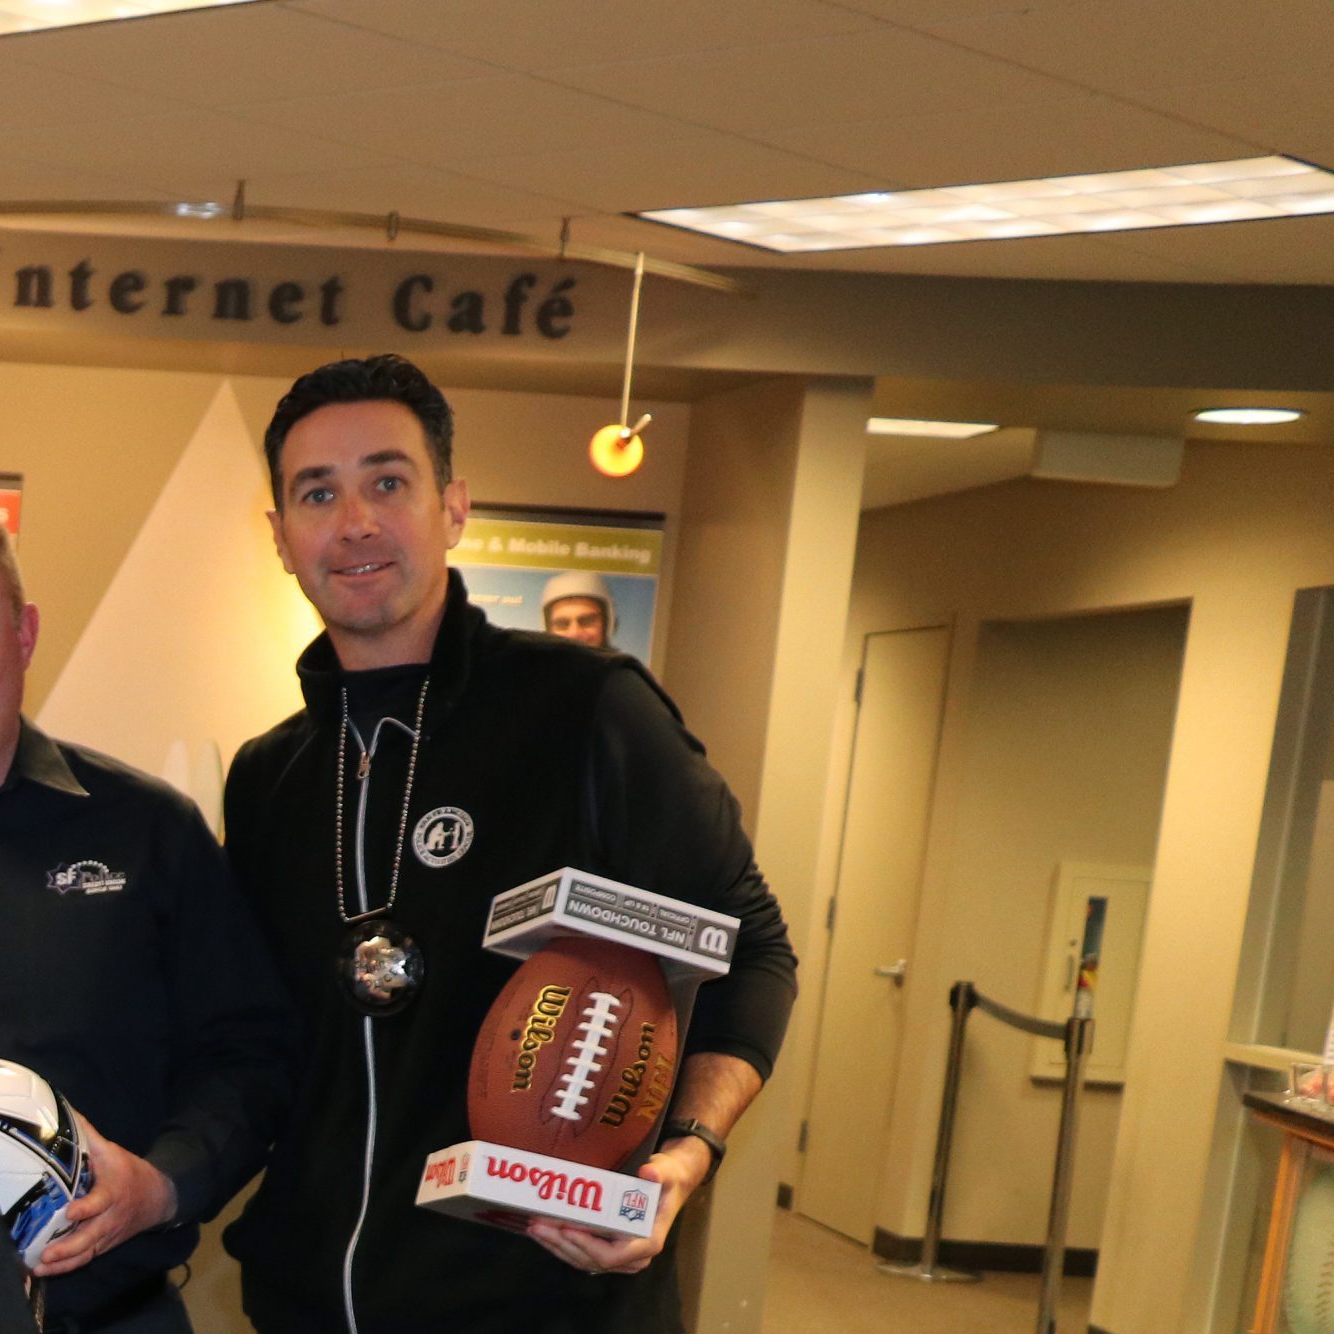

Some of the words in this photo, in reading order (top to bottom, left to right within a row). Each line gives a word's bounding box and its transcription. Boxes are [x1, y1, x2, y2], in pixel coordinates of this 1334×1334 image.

[391, 272, 576, 340] Café
[508, 537, 571, 556] Mobile
[574, 541, 652, 565] Banking
[567, 898, 658, 937] TOUCHDOWN
[659, 926, 687, 945] NFL
[512, 983, 574, 1093] Wilson
[598, 1021, 656, 1129] Wilson
[486, 1154, 604, 1213] Wilson
